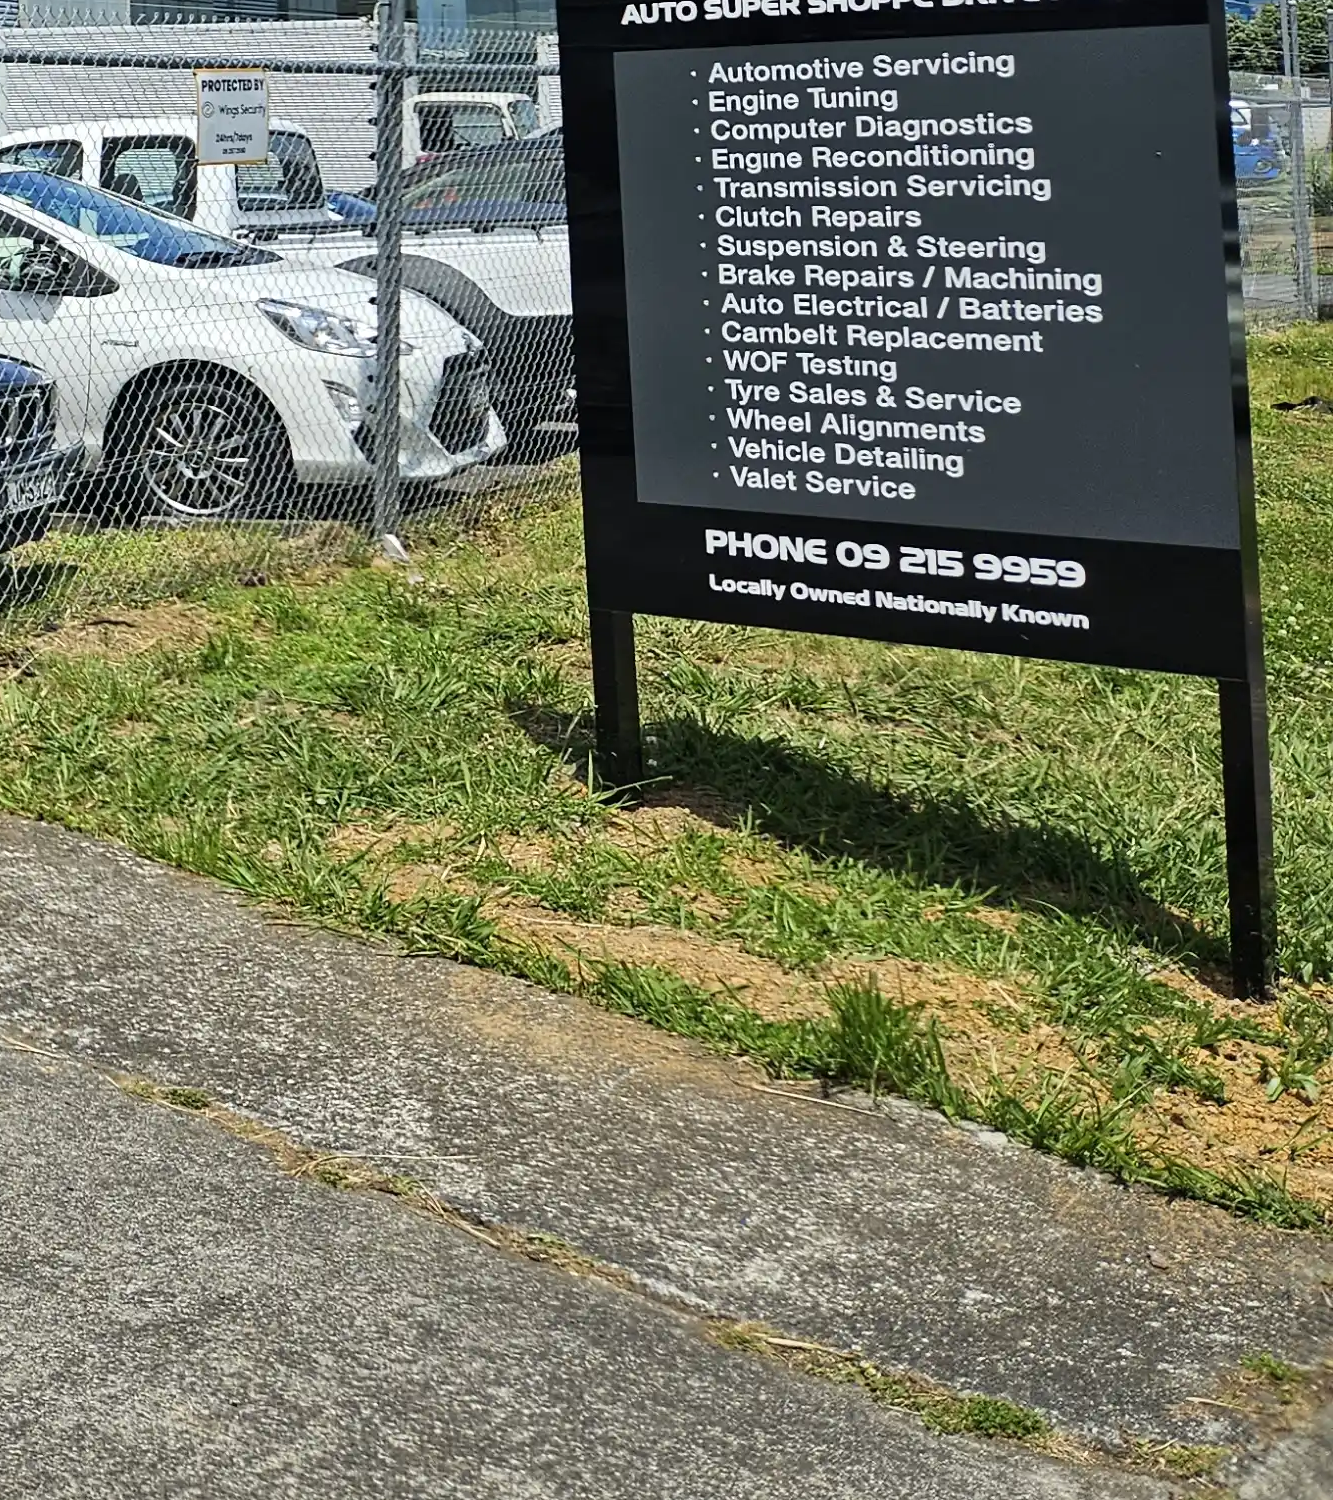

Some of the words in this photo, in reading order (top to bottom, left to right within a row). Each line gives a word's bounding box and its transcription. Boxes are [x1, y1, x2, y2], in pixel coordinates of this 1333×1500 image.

[621, 1, 697, 24] AUTO
[709, 58, 863, 83] Automotive
[873, 51, 1014, 77] Servicing
[201, 79, 253, 92] PROTECTED
[254, 79, 264, 91] BY
[709, 90, 799, 115] Engine
[807, 86, 898, 111] Tuning
[218, 104, 239, 119] Wings
[241, 103, 265, 118] Security
[711, 119, 846, 144] Computer
[856, 113, 1032, 141] Diagnostics
[712, 149, 802, 174] Engine
[813, 143, 1034, 170] Reconditioning
[714, 176, 897, 198] Transmission
[907, 175, 1051, 201] Servicing
[716, 206, 801, 227] Clutch
[812, 206, 921, 231] Repairs
[718, 235, 877, 261] Suspension
[888, 236, 908, 257] &
[917, 236, 1045, 264] Steering
[719, 264, 795, 285] Brake
[805, 265, 914, 291] Repairs
[945, 267, 1102, 296] Machining
[722, 293, 783, 314] Auto
[794, 294, 927, 318] Electrical
[960, 298, 1103, 322] Batteries
[722, 321, 837, 345] Cambelt
[847, 325, 1043, 352] Replacement
[723, 350, 787, 372] WOF
[796, 353, 897, 382] Testing
[725, 379, 780, 405] Tyre
[789, 382, 866, 406] Sales
[876, 386, 897, 407] &
[906, 387, 1021, 413] Service
[726, 408, 811, 432] Wheel
[821, 413, 985, 442] Alignments
[728, 437, 825, 463] Vehicle
[835, 443, 963, 477] Detailing
[730, 466, 797, 490] Valet
[806, 471, 915, 499] Service
[706, 530, 827, 564] PHONE
[836, 542, 889, 569] 09
[900, 547, 964, 576] 215
[973, 554, 1085, 587] 9959
[710, 574, 786, 600] Locally
[791, 583, 870, 606] Owned
[876, 591, 997, 622] Nationally
[1002, 604, 1089, 629] Known
